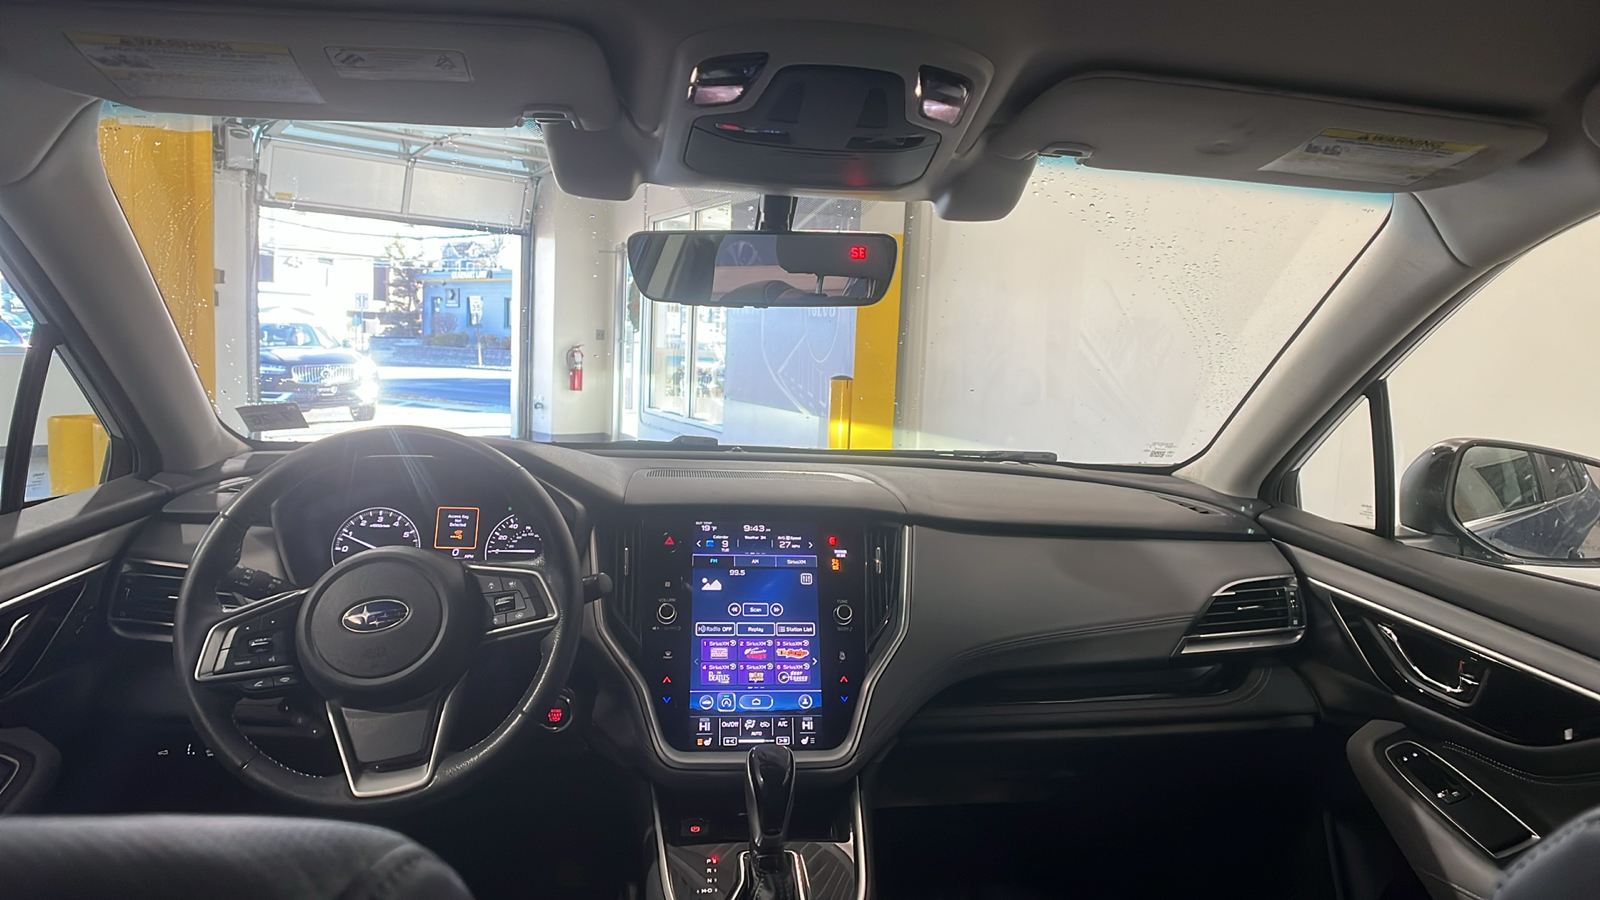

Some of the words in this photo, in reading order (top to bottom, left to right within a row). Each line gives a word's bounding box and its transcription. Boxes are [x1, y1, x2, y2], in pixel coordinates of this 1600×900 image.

[1372, 132, 1445, 149] WARNING
[850, 246, 866, 260] SE
[743, 524, 765, 532] 9:43
[721, 540, 729, 548] 9
[779, 541, 792, 549] 27
[451, 548, 460, 557] 0
[699, 722, 711, 731] HI
[778, 720, 788, 728] A/C
[801, 721, 814, 731] HI
